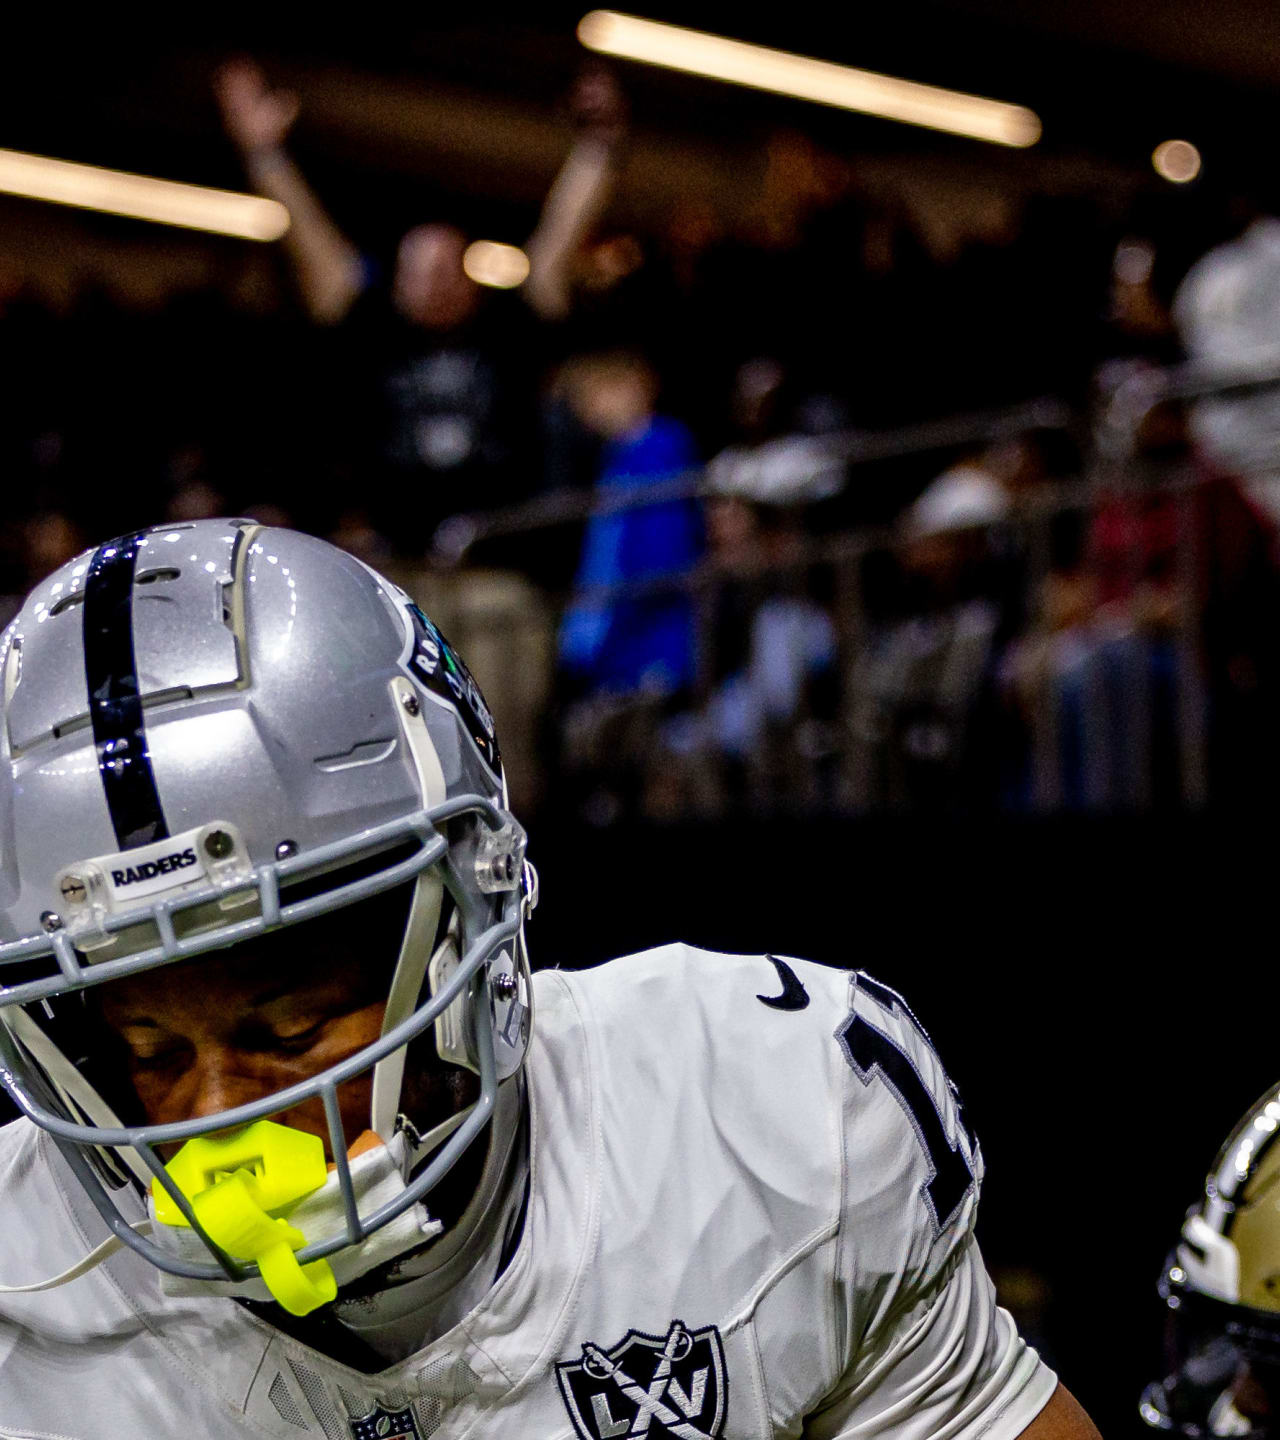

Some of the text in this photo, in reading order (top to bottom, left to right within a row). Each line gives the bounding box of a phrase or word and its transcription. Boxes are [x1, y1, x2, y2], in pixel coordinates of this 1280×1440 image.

[111, 847, 198, 888] RAIDERS
[833, 969, 976, 1244] 1
[590, 1366, 710, 1440] LXV
